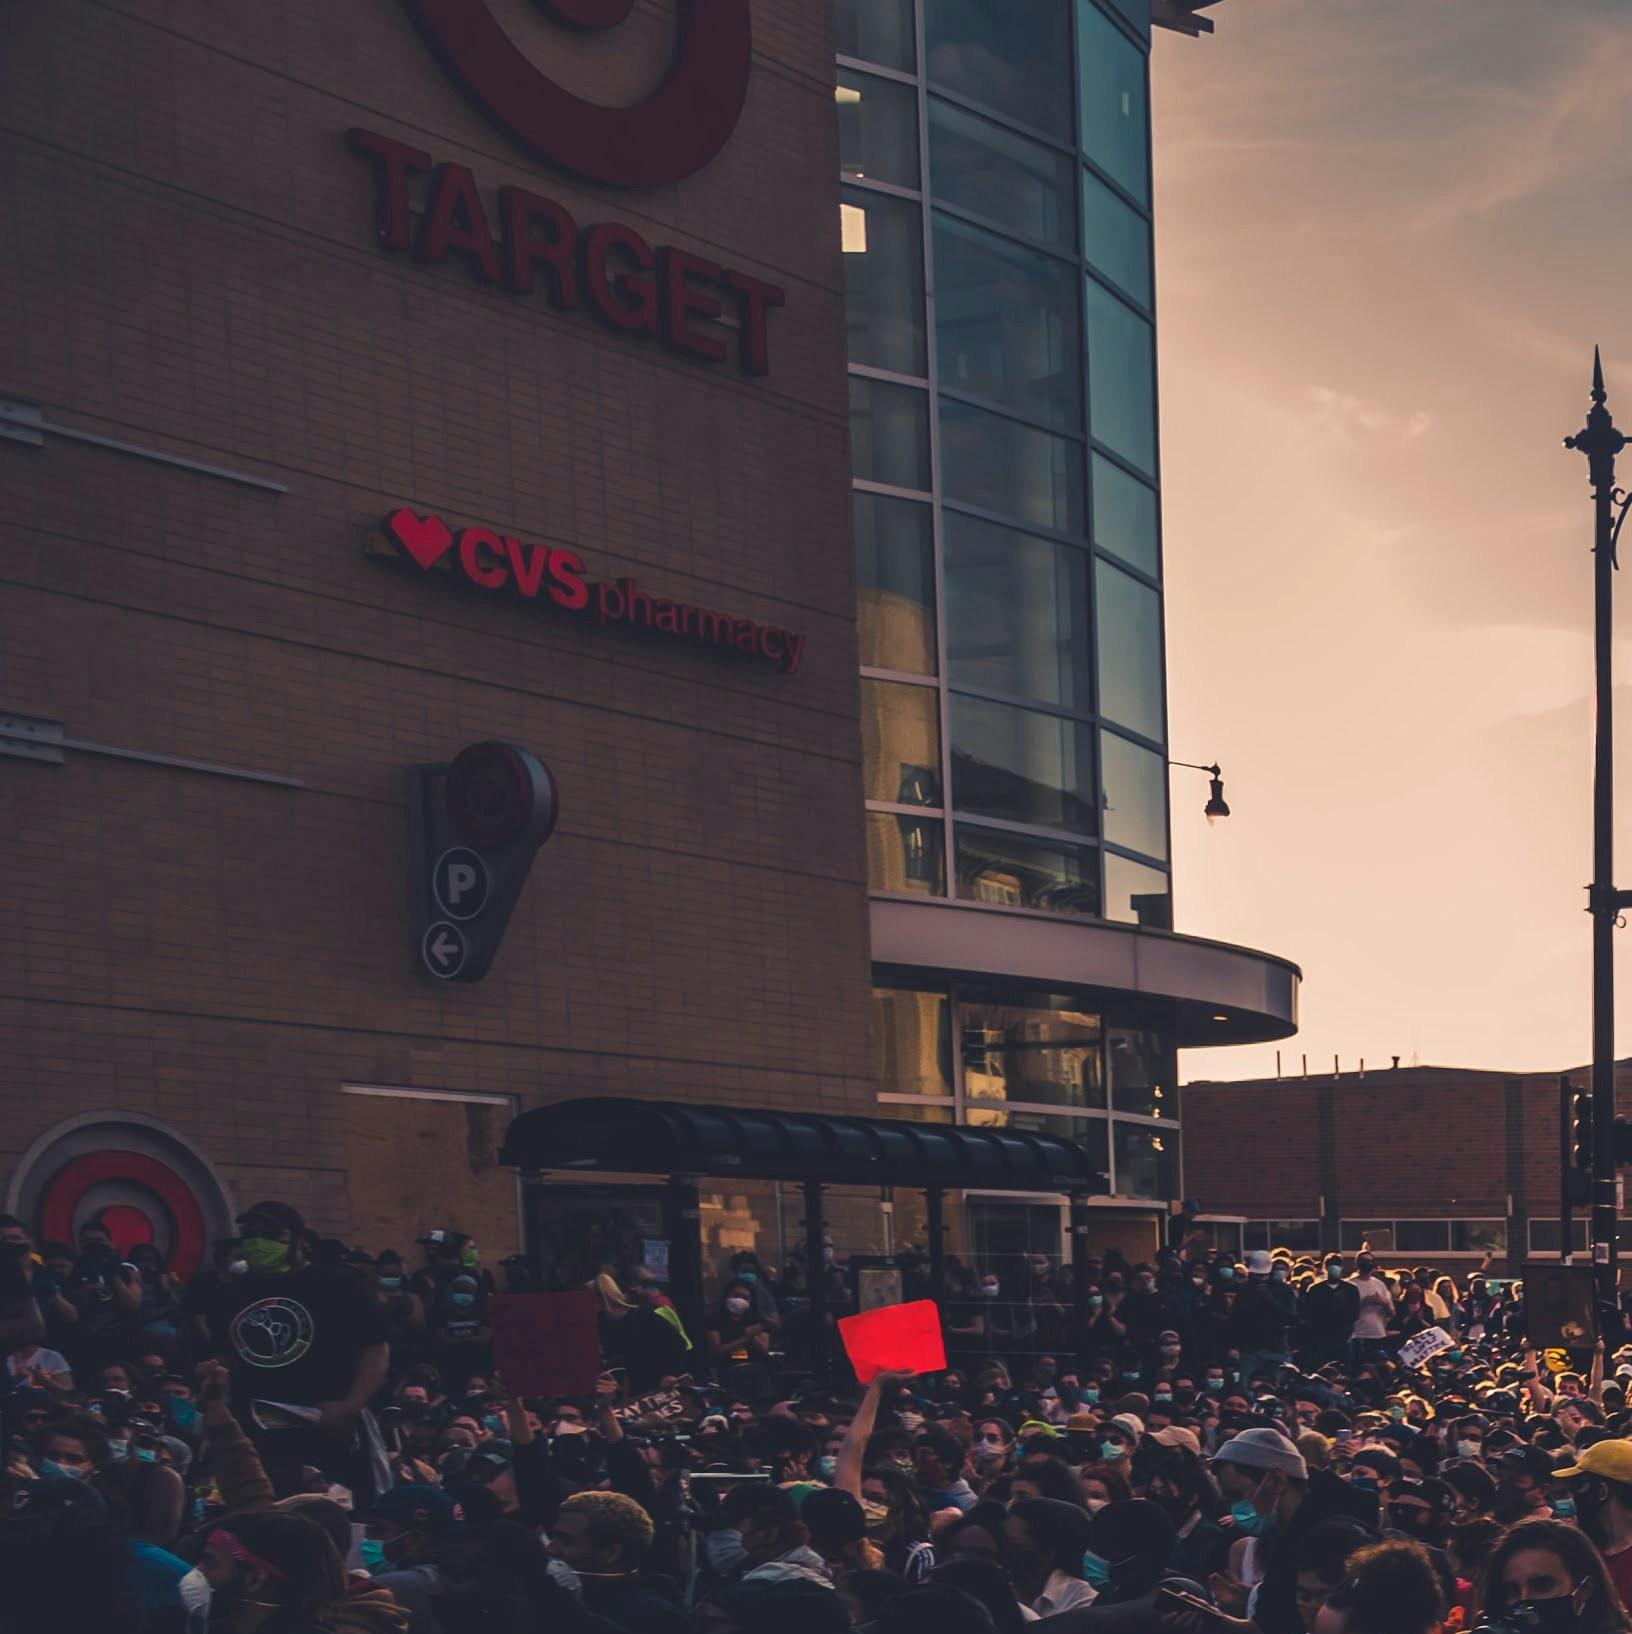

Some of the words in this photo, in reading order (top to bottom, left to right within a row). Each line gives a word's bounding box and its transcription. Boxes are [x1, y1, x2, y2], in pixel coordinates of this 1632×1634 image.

[345, 127, 787, 378] TARGET
[459, 528, 590, 611] CVS
[599, 577, 807, 674] pharmacy
[446, 863, 478, 905] P
